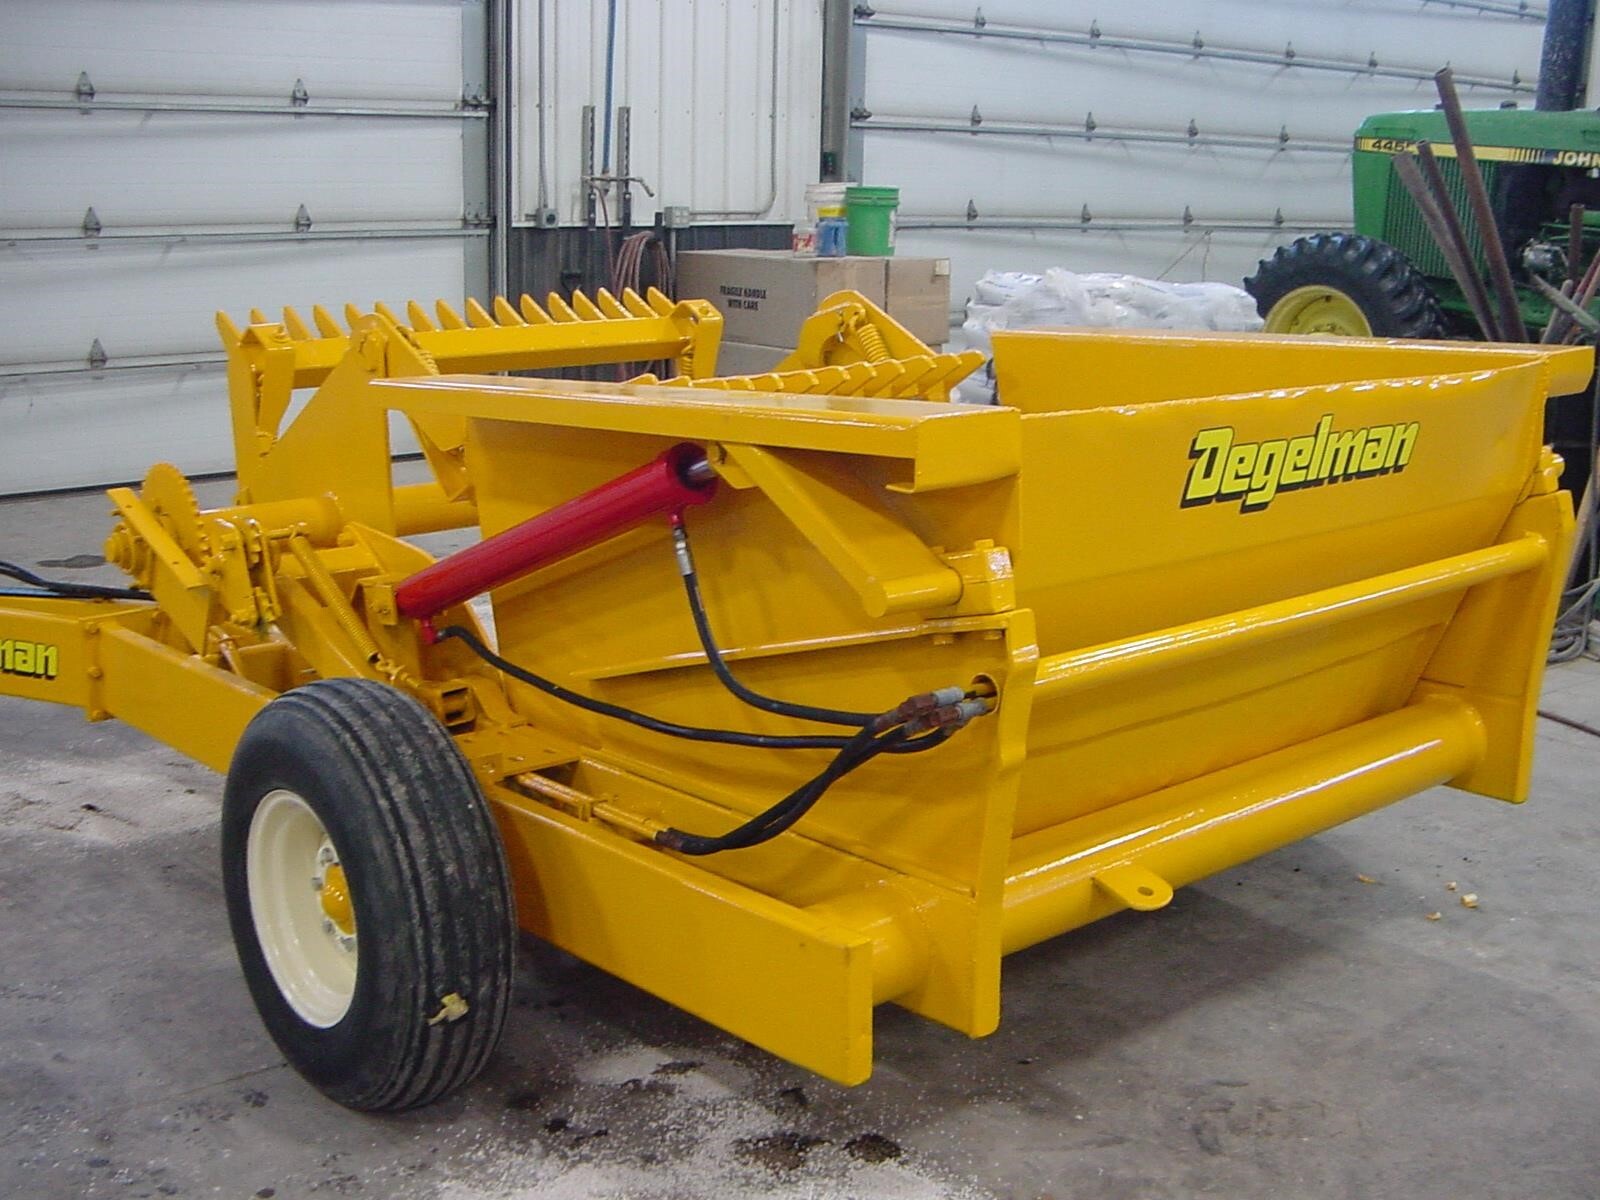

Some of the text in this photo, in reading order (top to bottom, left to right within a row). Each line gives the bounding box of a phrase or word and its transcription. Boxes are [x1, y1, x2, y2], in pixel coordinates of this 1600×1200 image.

[720, 285, 767, 299] FRAGILE HANDLE
[728, 299, 759, 311] WITH CARE
[1180, 414, 1420, 513] Degelman
